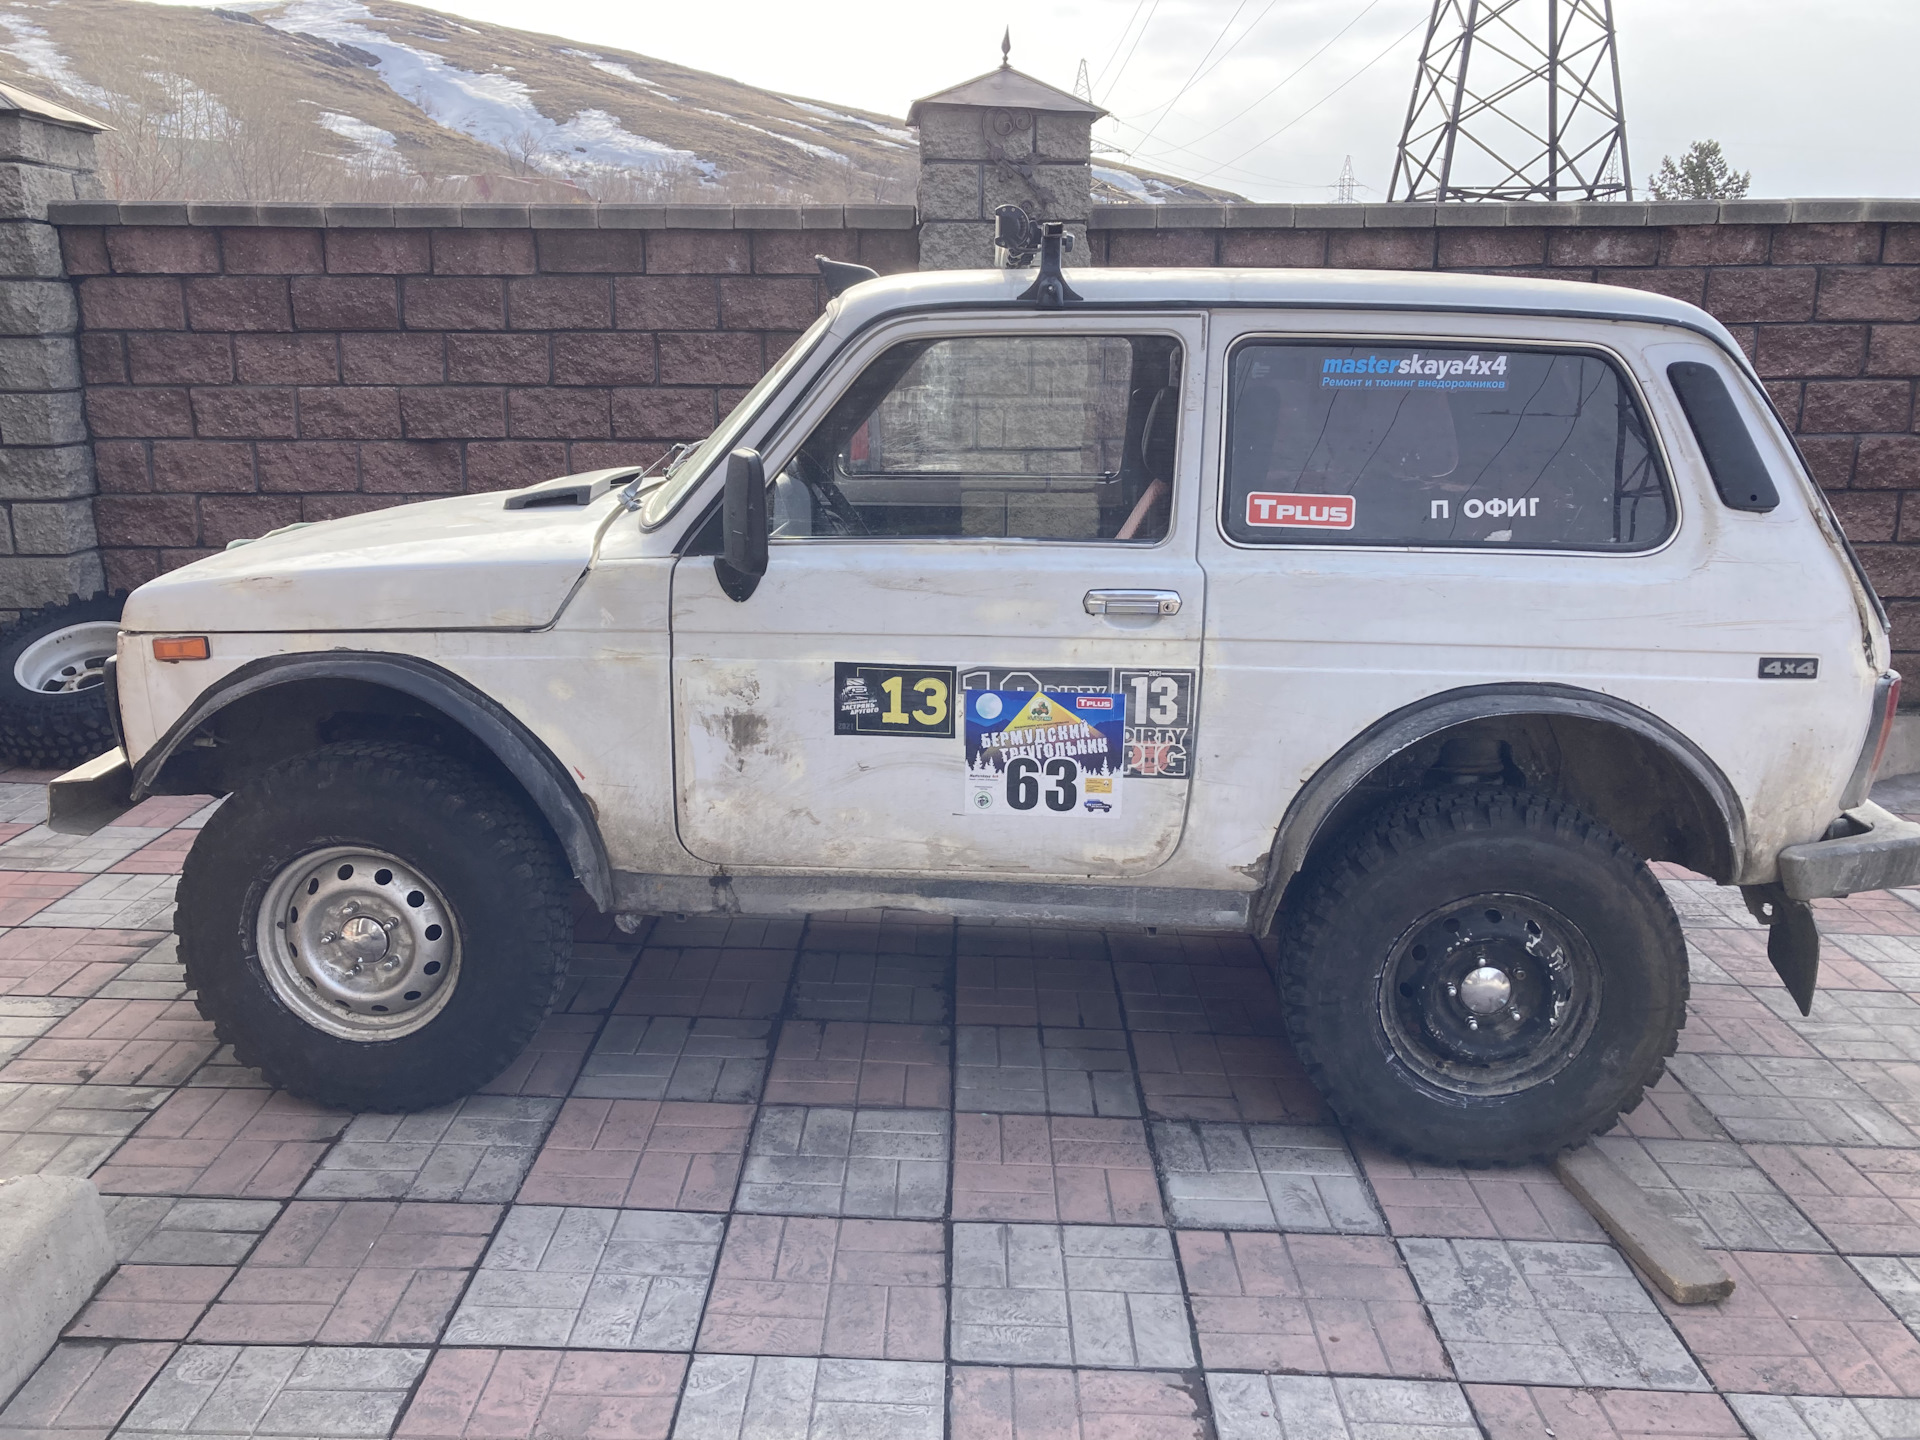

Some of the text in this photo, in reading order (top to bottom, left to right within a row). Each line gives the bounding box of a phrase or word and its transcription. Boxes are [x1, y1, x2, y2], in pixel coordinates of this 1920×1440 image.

[1322, 354, 1508, 380] masterskaya4x4
[1322, 377, 1506, 390] Ремонт и тюнинг внедорожников
[1463, 498, 1540, 519] ОФИГ
[881, 676, 948, 726] 13
[1131, 676, 1178, 725] 13
[980, 719, 1091, 749] БЕРМУДСКИЙ
[1124, 727, 1189, 746] DIRTY
[999, 737, 1109, 763] ТРЕУГОЛЬНИК
[1005, 756, 1078, 812] 63
